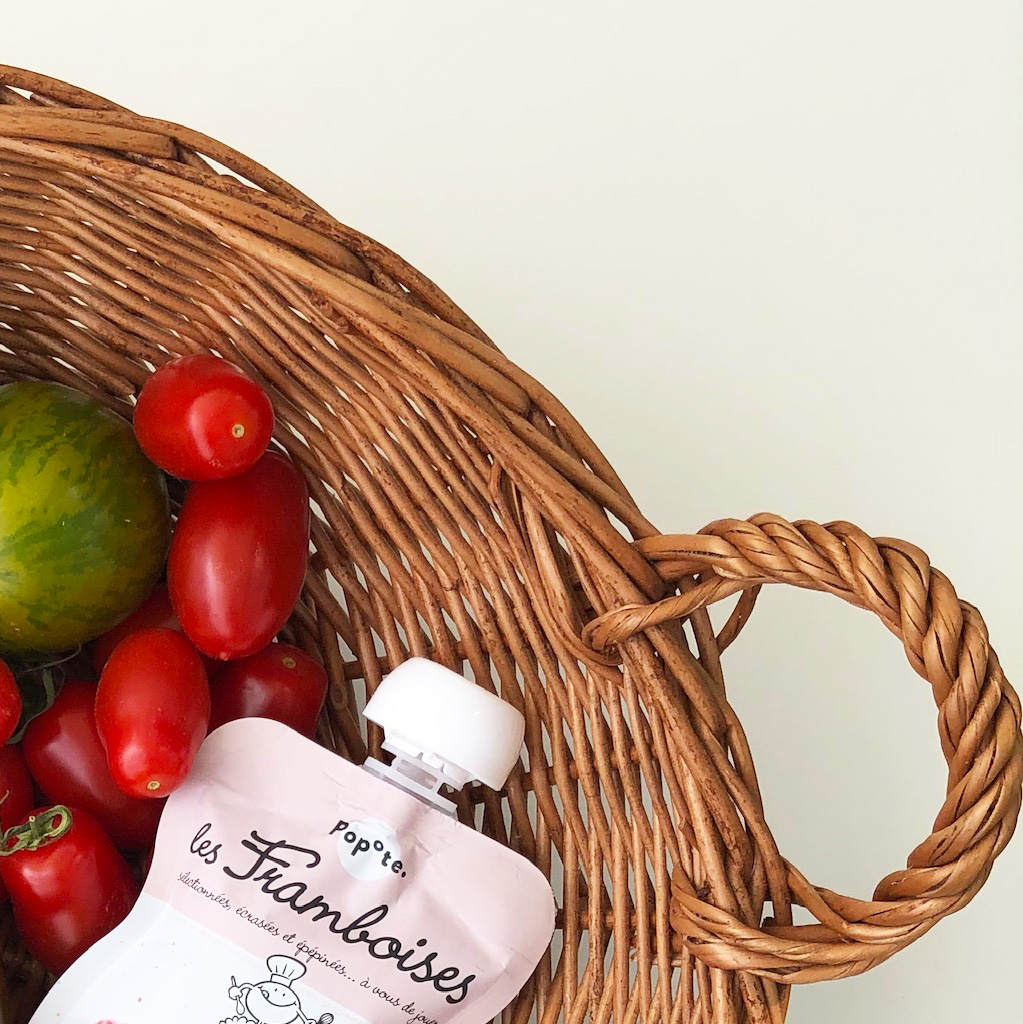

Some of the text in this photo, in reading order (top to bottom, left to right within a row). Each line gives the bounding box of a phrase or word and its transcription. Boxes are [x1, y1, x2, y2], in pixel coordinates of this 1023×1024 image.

[189, 822, 477, 1004] les Framboises
[236, 907, 281, 936] écrasées
[282, 933, 297, 944] et
[360, 976, 370, 989] à
[372, 986, 401, 1006] vous
[401, 1002, 416, 1015] de
